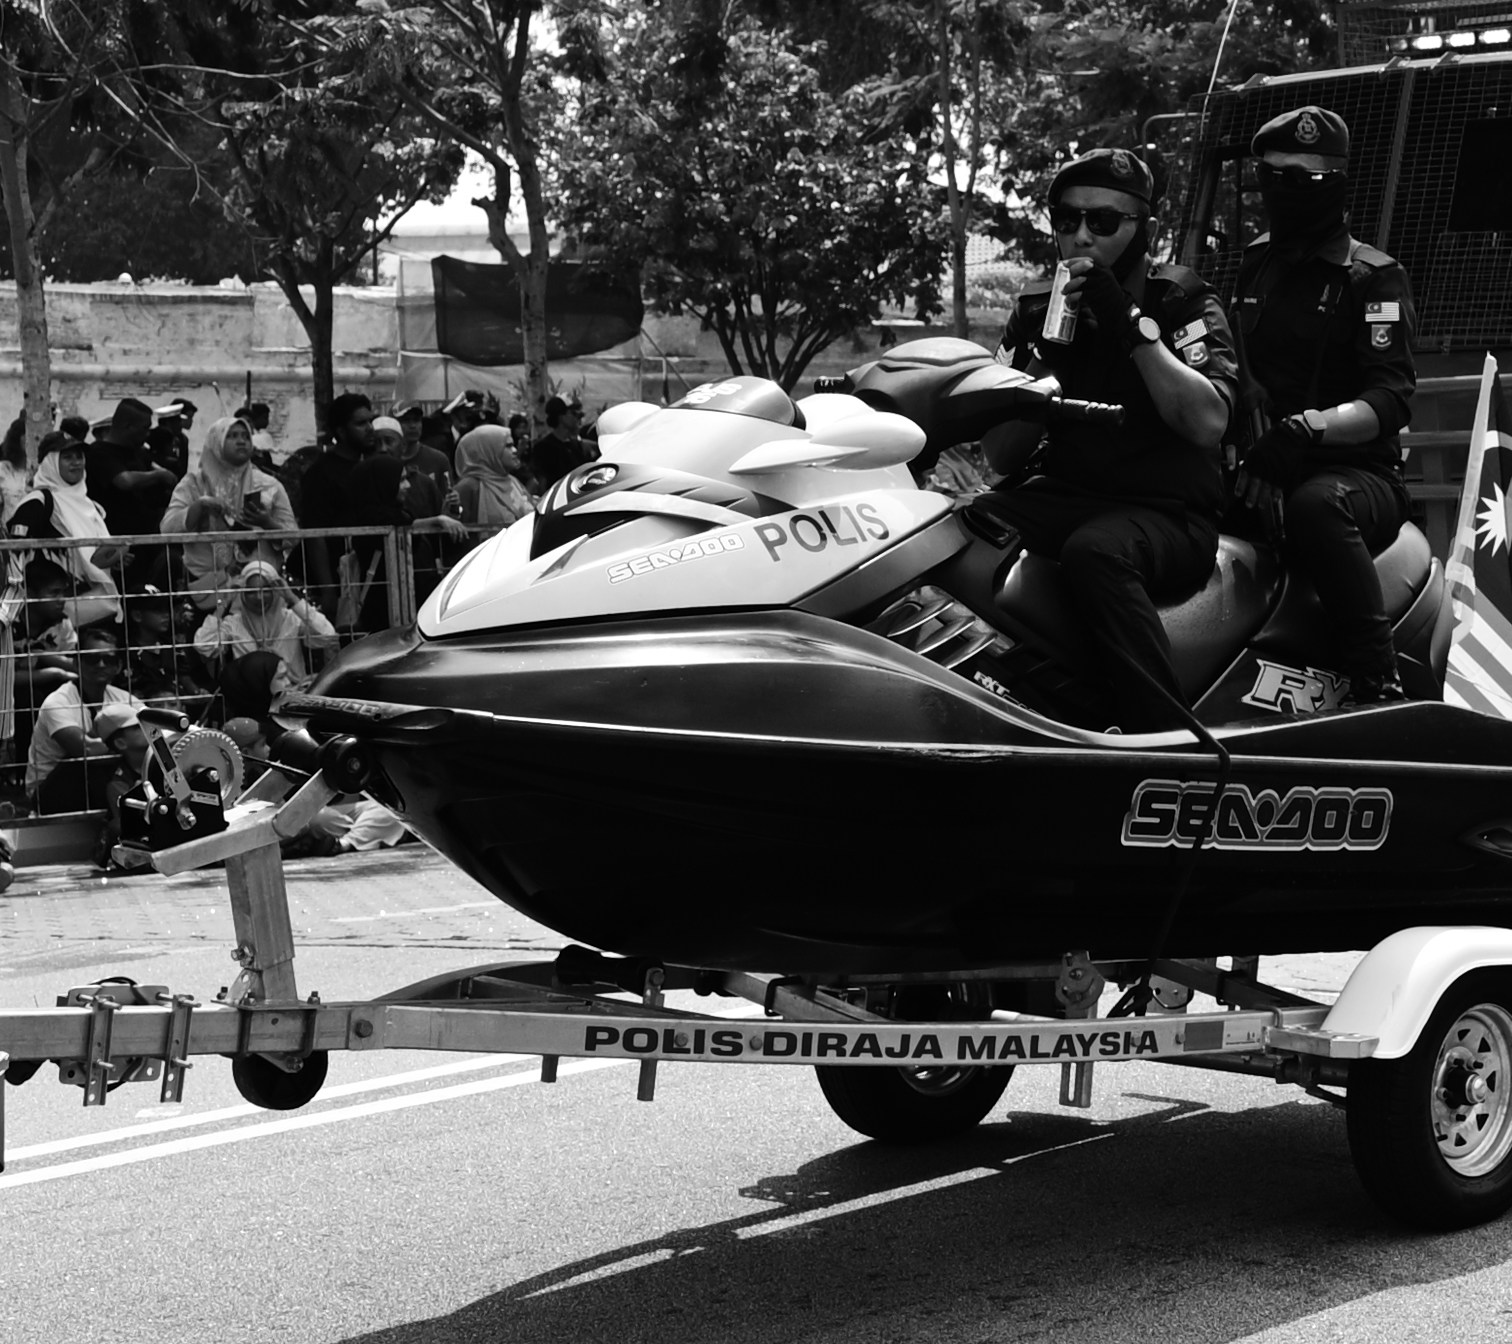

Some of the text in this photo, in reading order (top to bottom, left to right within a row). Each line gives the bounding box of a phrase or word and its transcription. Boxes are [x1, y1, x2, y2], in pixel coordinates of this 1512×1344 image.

[753, 503, 890, 563] POLIS
[584, 1025, 1159, 1061] POLIS DIRAJA MALAYSIA
